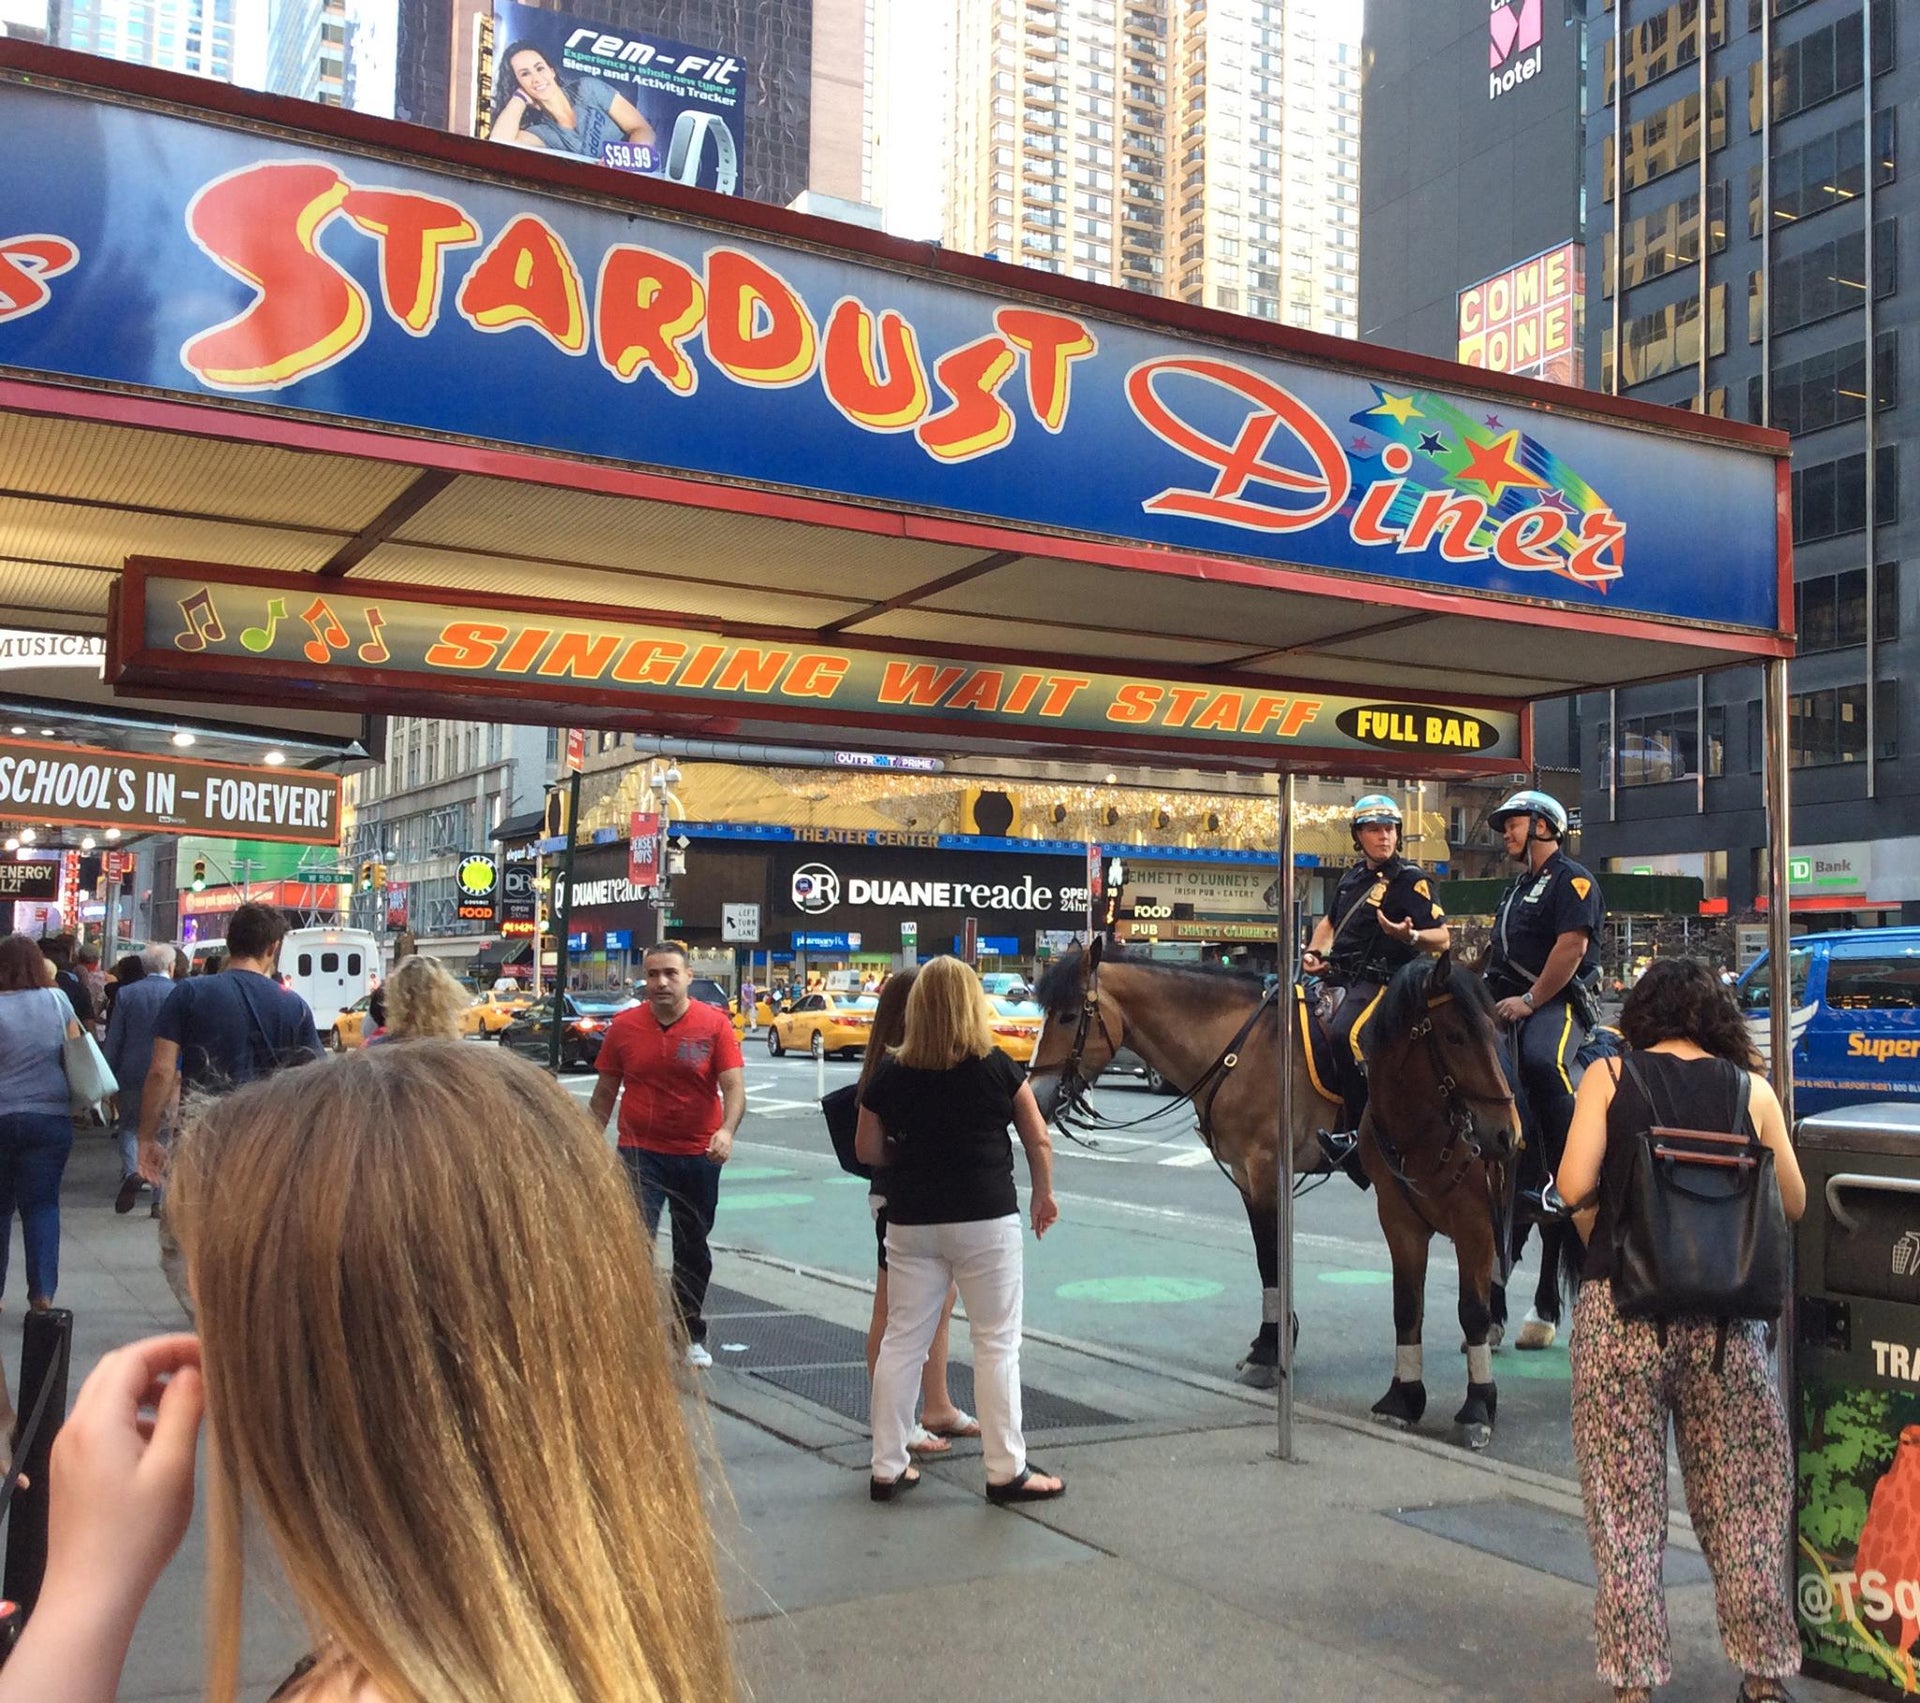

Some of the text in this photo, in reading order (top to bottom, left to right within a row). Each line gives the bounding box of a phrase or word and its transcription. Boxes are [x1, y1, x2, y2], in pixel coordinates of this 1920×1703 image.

[562, 57, 737, 107] Sleep and Activity Tracker
[563, 48, 627, 70] Experience
[638, 66, 671, 80] whole
[673, 76, 696, 87] new
[697, 80, 724, 93] type
[725, 87, 737, 96] of
[1489, 45, 1542, 100] hotel
[605, 143, 651, 169] $59.99
[1460, 251, 1566, 333] COME
[180, 158, 1098, 464] STARDUST
[1124, 354, 1627, 580] Diner
[425, 621, 1323, 738] SINGING WAIT STAFF
[1356, 710, 1482, 749] FULL BAR
[792, 826, 939, 848] THEATER CENTER
[1129, 871, 1183, 885] EMMETT
[1790, 858, 1852, 880] TD Bank
[1174, 886, 1254, 899] IRISH PUB EATERY
[459, 906, 493, 918] FOOD
[738, 908, 756, 918] LEFT
[1134, 905, 1172, 918] FOOD
[738, 919, 757, 928] TURN
[738, 929, 756, 938] LANE
[1131, 923, 1159, 935] PUB
